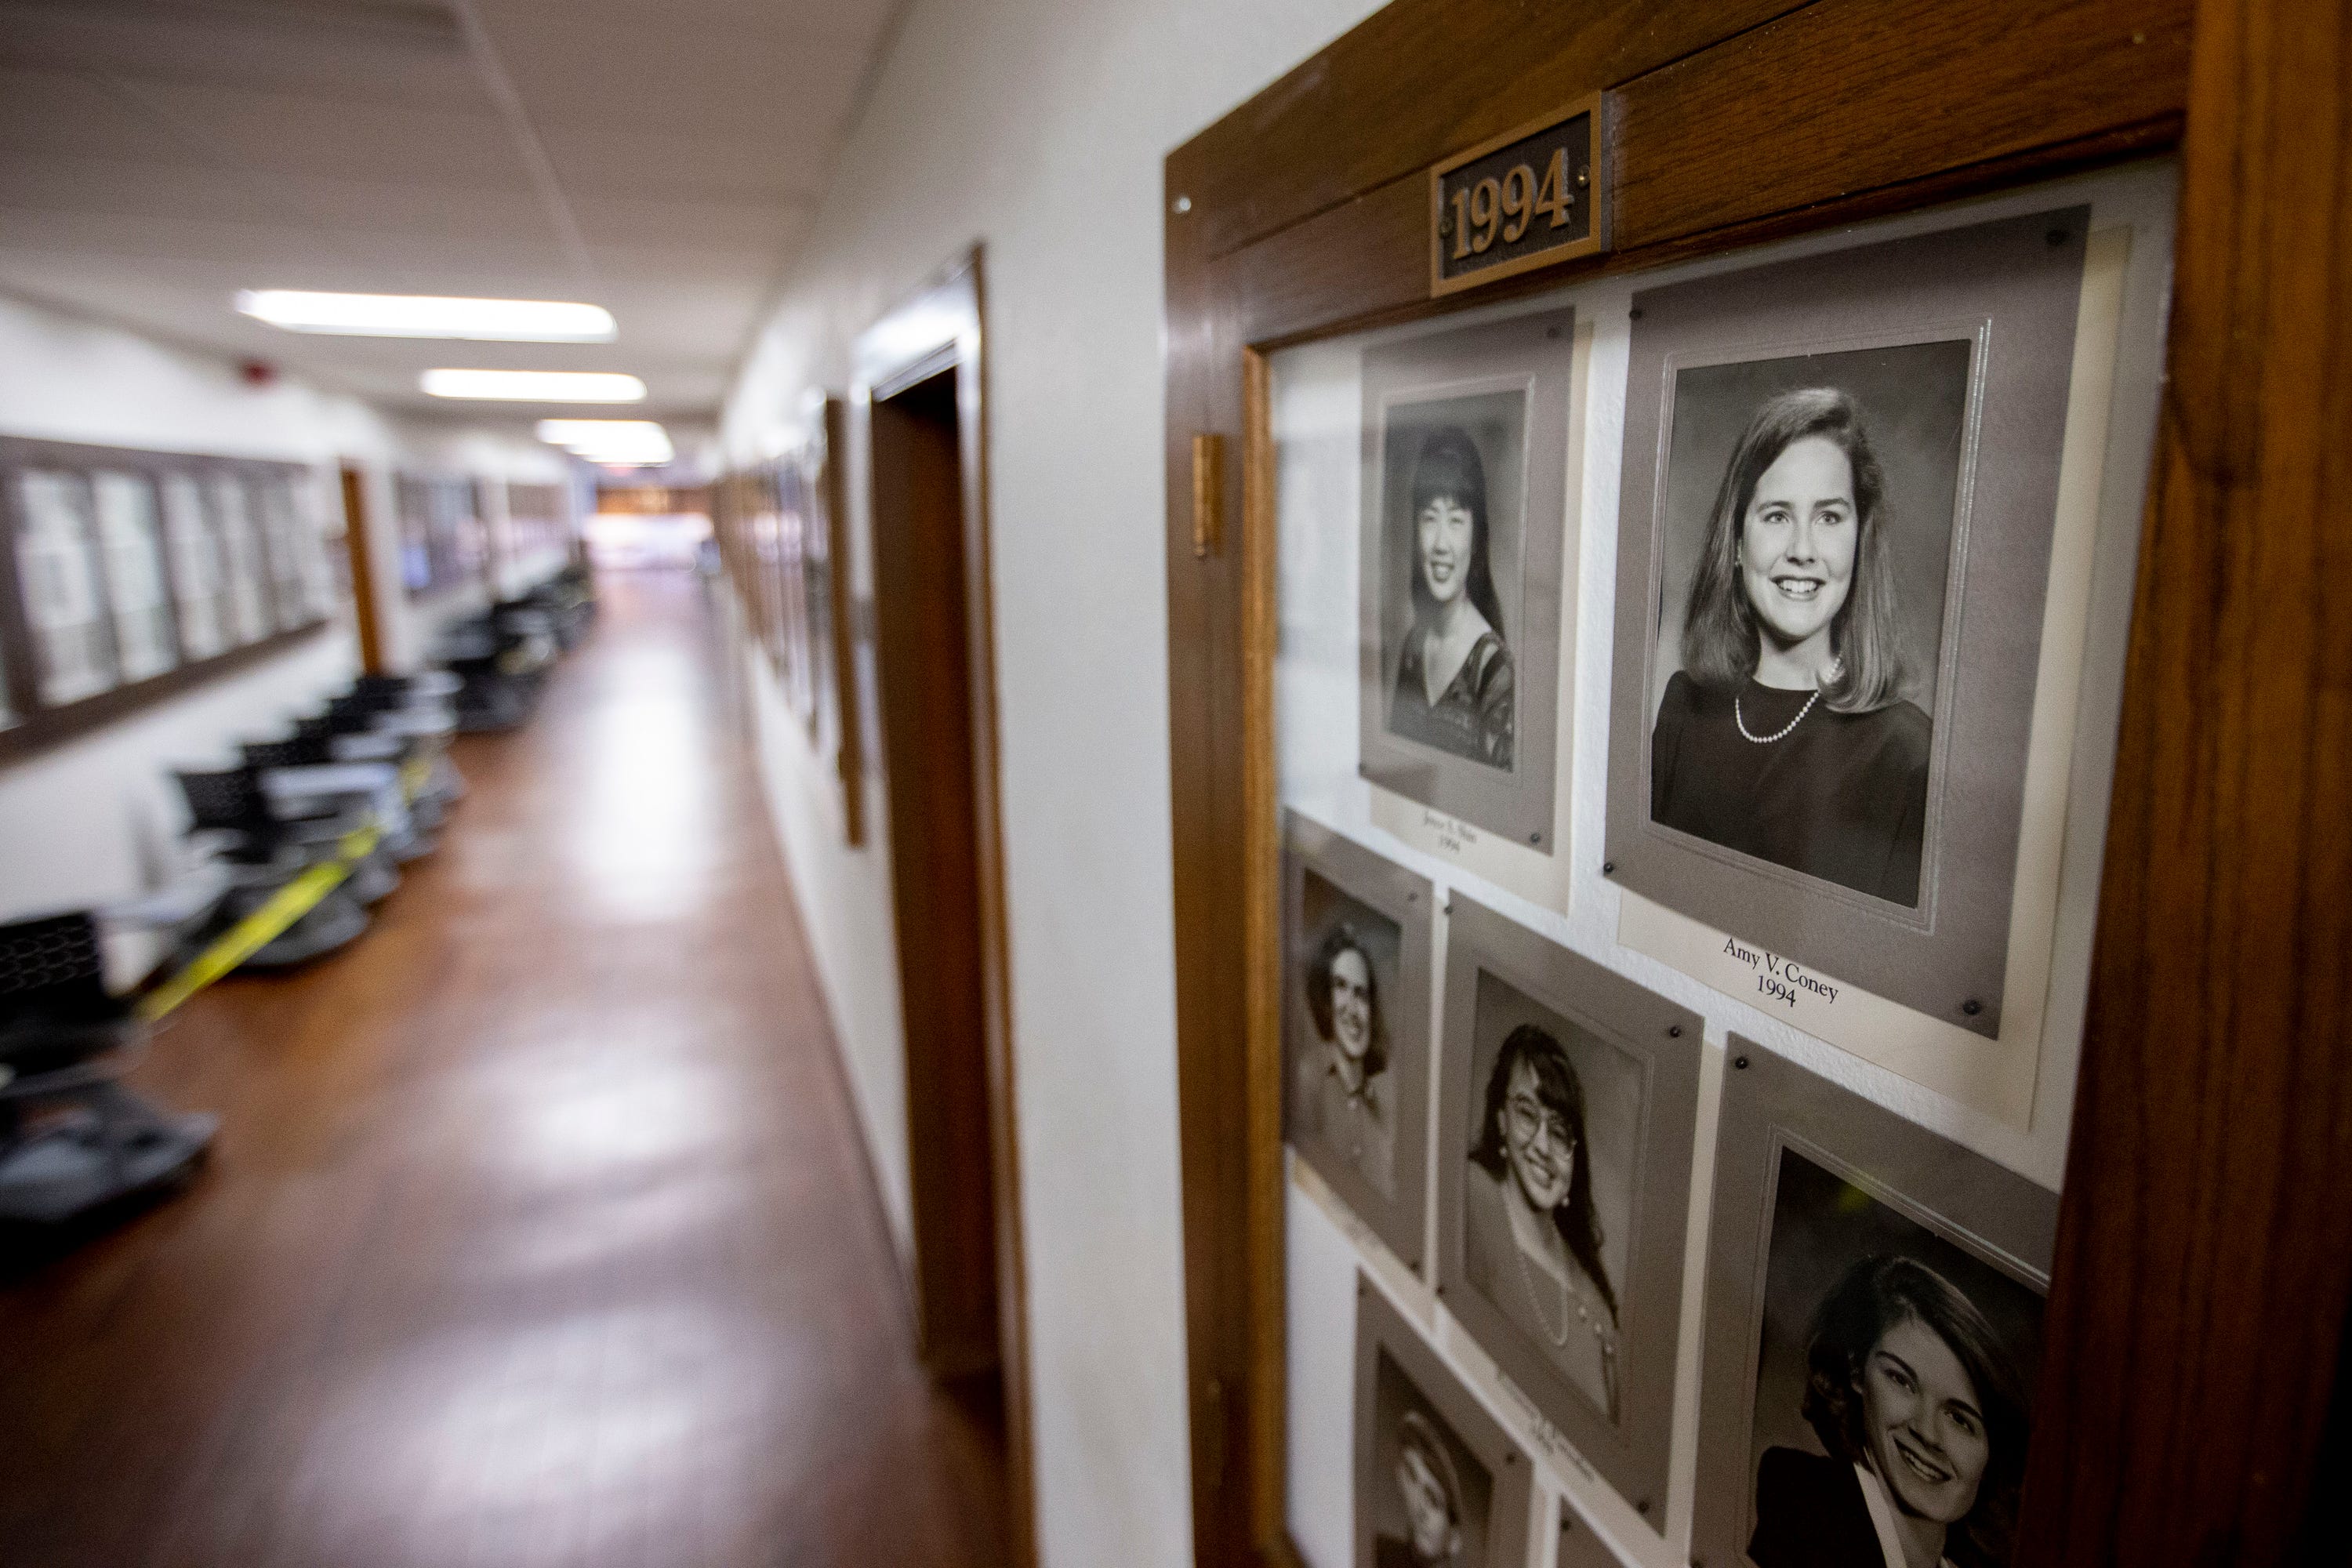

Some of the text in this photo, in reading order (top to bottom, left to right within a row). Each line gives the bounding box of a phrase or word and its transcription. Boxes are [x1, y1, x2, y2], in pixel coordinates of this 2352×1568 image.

[1451, 147, 1574, 260] 1994
[1723, 937, 1838, 1004] Amy V. Coney
[1758, 975, 1797, 1008] 1994
